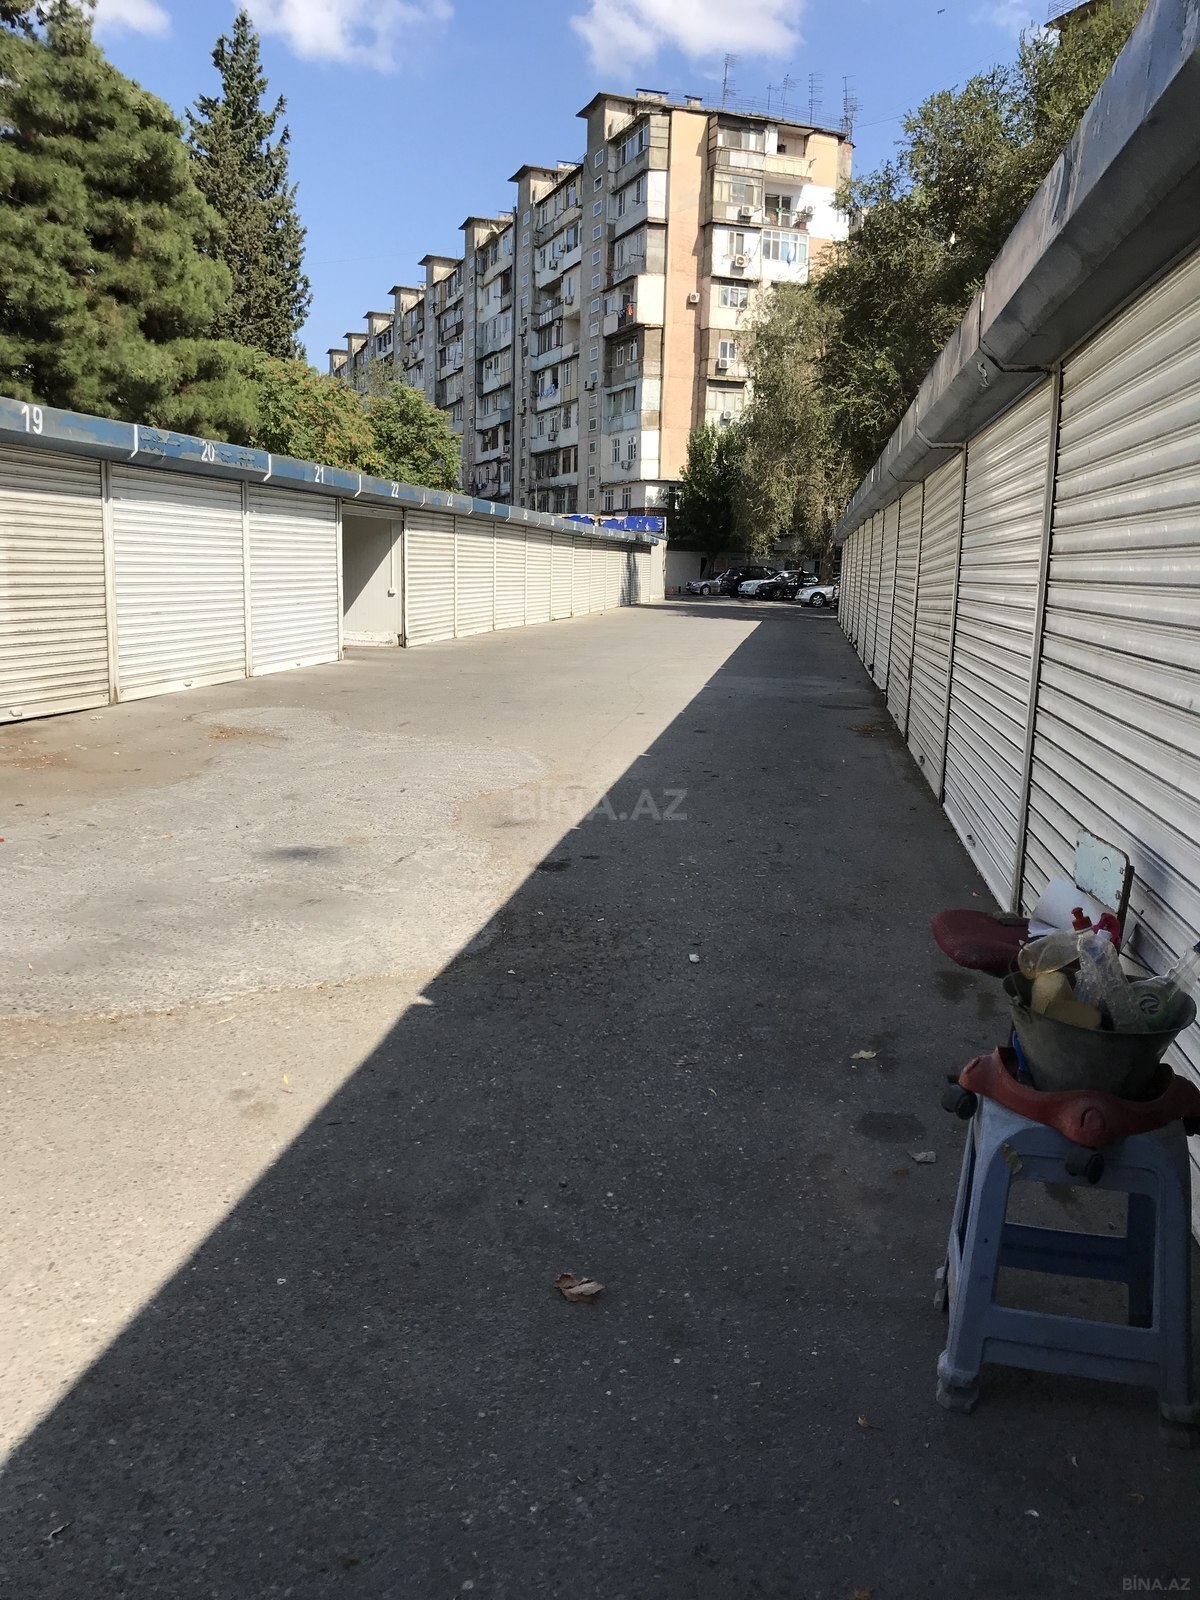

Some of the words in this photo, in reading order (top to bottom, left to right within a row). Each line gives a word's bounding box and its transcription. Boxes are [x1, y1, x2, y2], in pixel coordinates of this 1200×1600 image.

[21, 404, 43, 435] 19
[201, 441, 215, 462] 20
[314, 465, 325, 484] 21
[391, 482, 399, 498] 22
